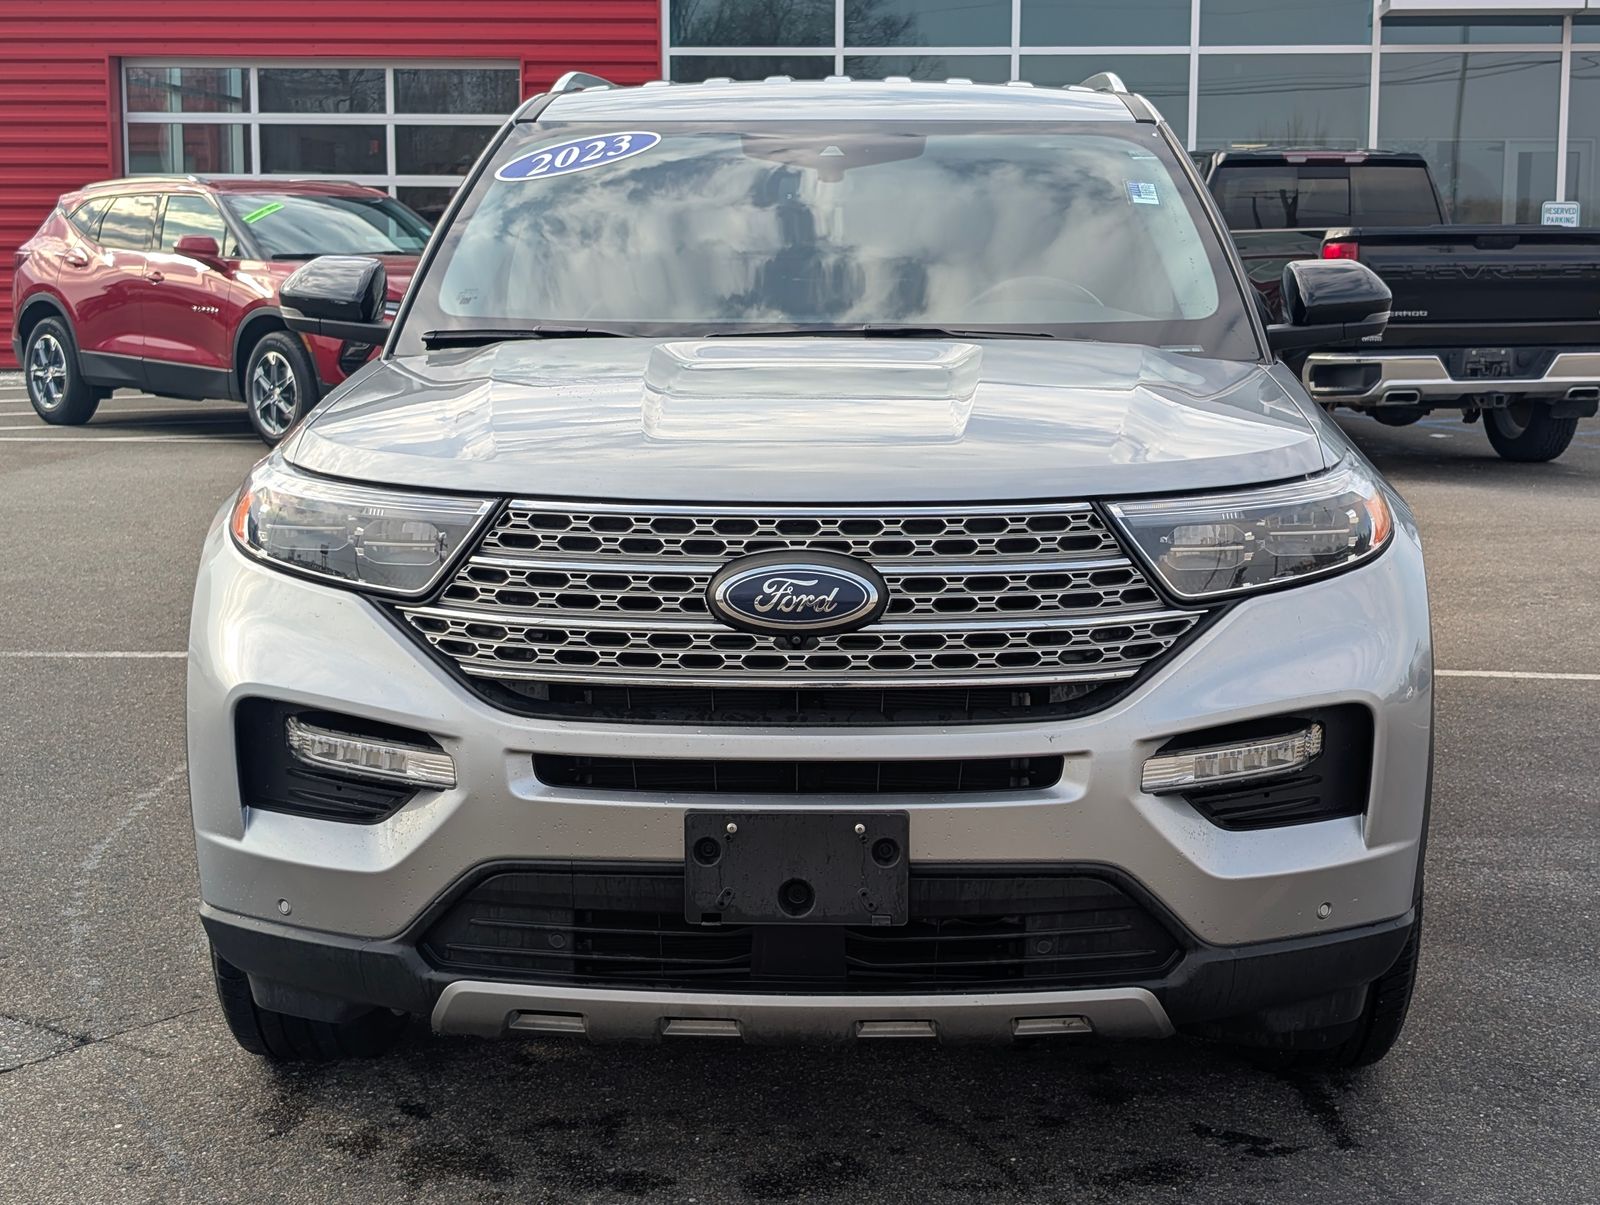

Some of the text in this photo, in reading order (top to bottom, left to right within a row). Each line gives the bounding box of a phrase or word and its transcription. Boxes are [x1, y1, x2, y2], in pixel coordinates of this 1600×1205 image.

[526, 135, 633, 177] 2023
[1544, 207, 1577, 215] RESERVED
[1546, 216, 1575, 225] PARKING
[753, 577, 840, 613] Ford
